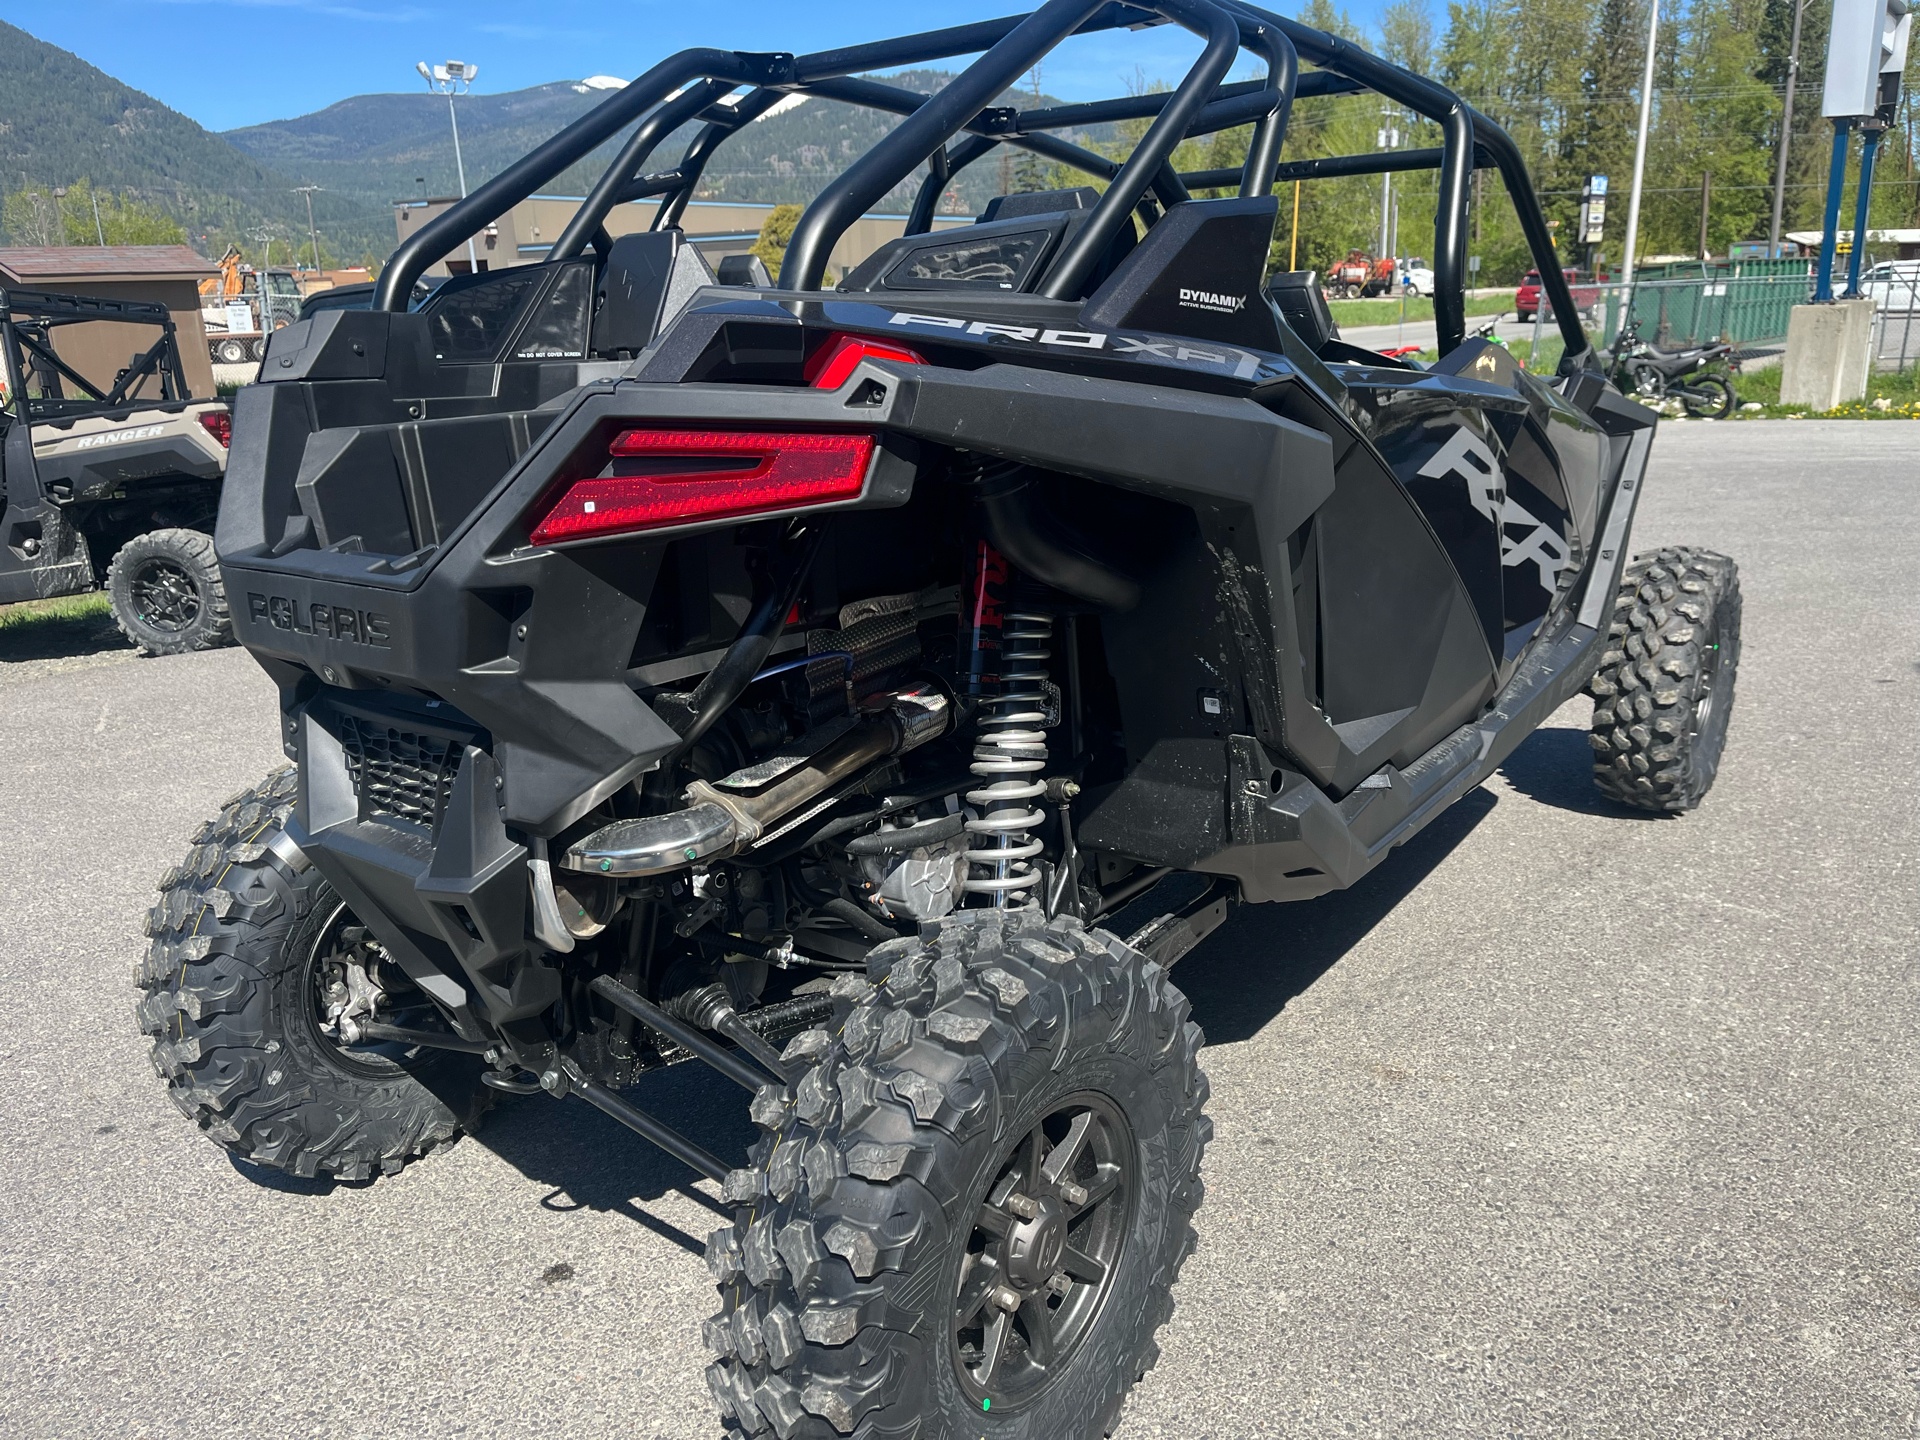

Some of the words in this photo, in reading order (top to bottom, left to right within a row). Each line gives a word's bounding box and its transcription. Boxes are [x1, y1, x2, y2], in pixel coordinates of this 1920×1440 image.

[1178, 301, 1200, 309] ACTIVE
[1199, 304, 1234, 314] SUSPENSION
[1179, 288, 1247, 313] DYNAMIX
[888, 312, 1107, 350] PRO
[77, 425, 165, 448] RANGER
[1416, 425, 1571, 596] RZR
[247, 591, 392, 650] POLARIS
